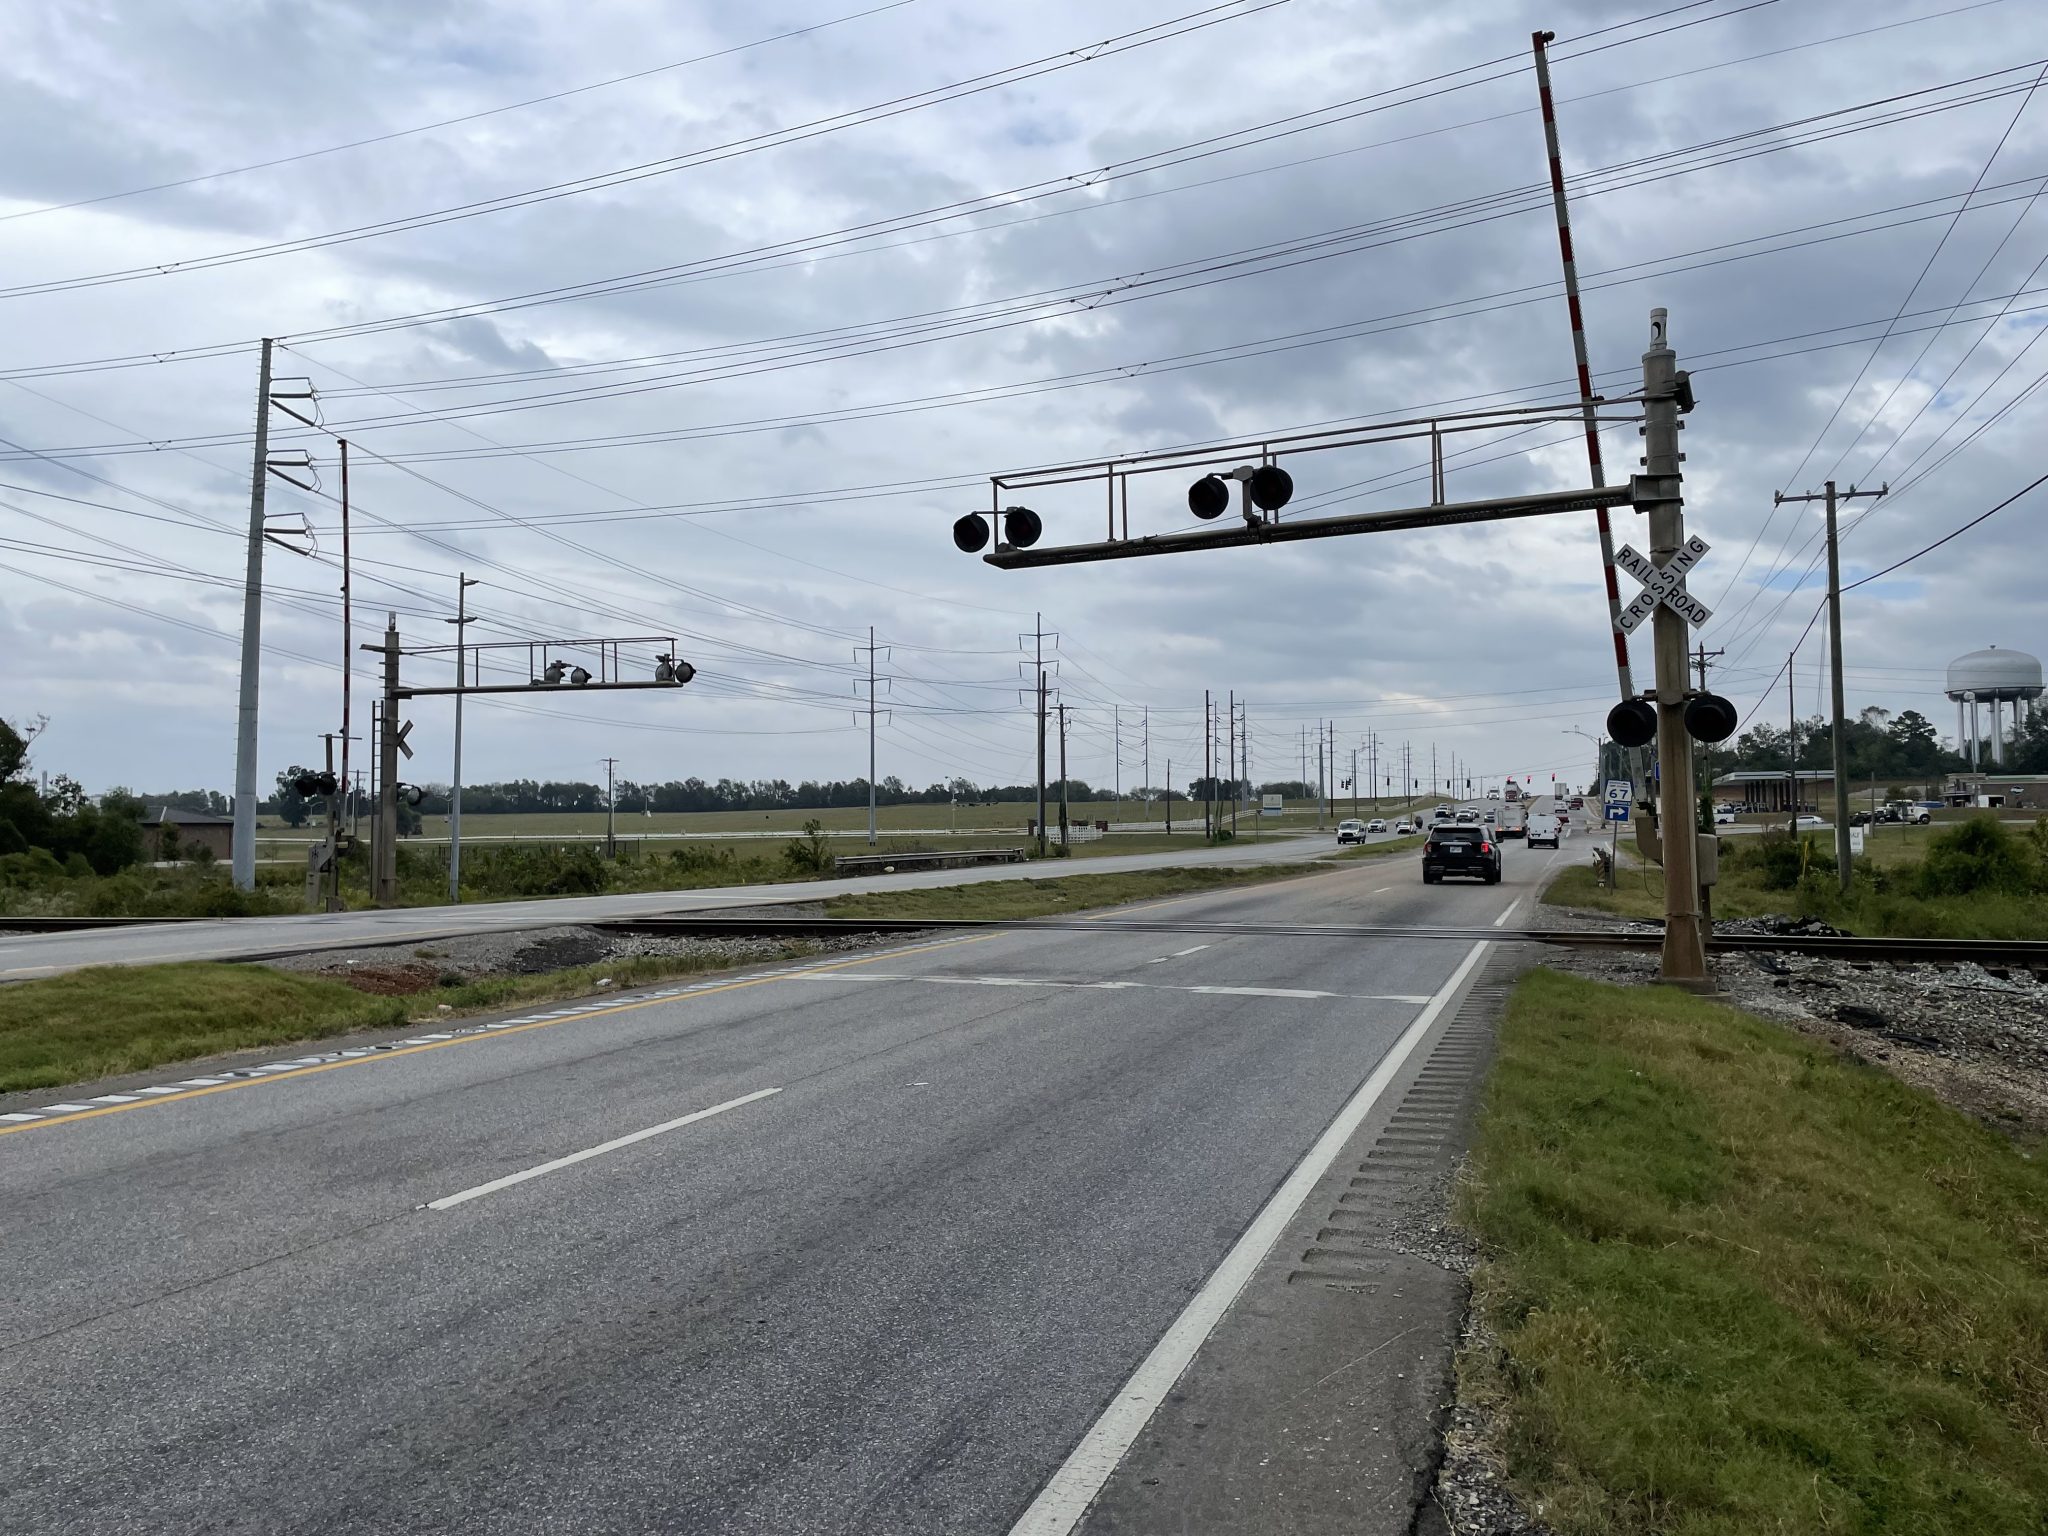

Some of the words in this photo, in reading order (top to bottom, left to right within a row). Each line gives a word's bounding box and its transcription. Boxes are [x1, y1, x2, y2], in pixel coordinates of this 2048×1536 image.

[1617, 548, 1654, 583] RAIL
[1665, 588, 1706, 622] ROAD
[1620, 540, 1704, 629] CROSSING
[1609, 789, 1628, 799] 67
